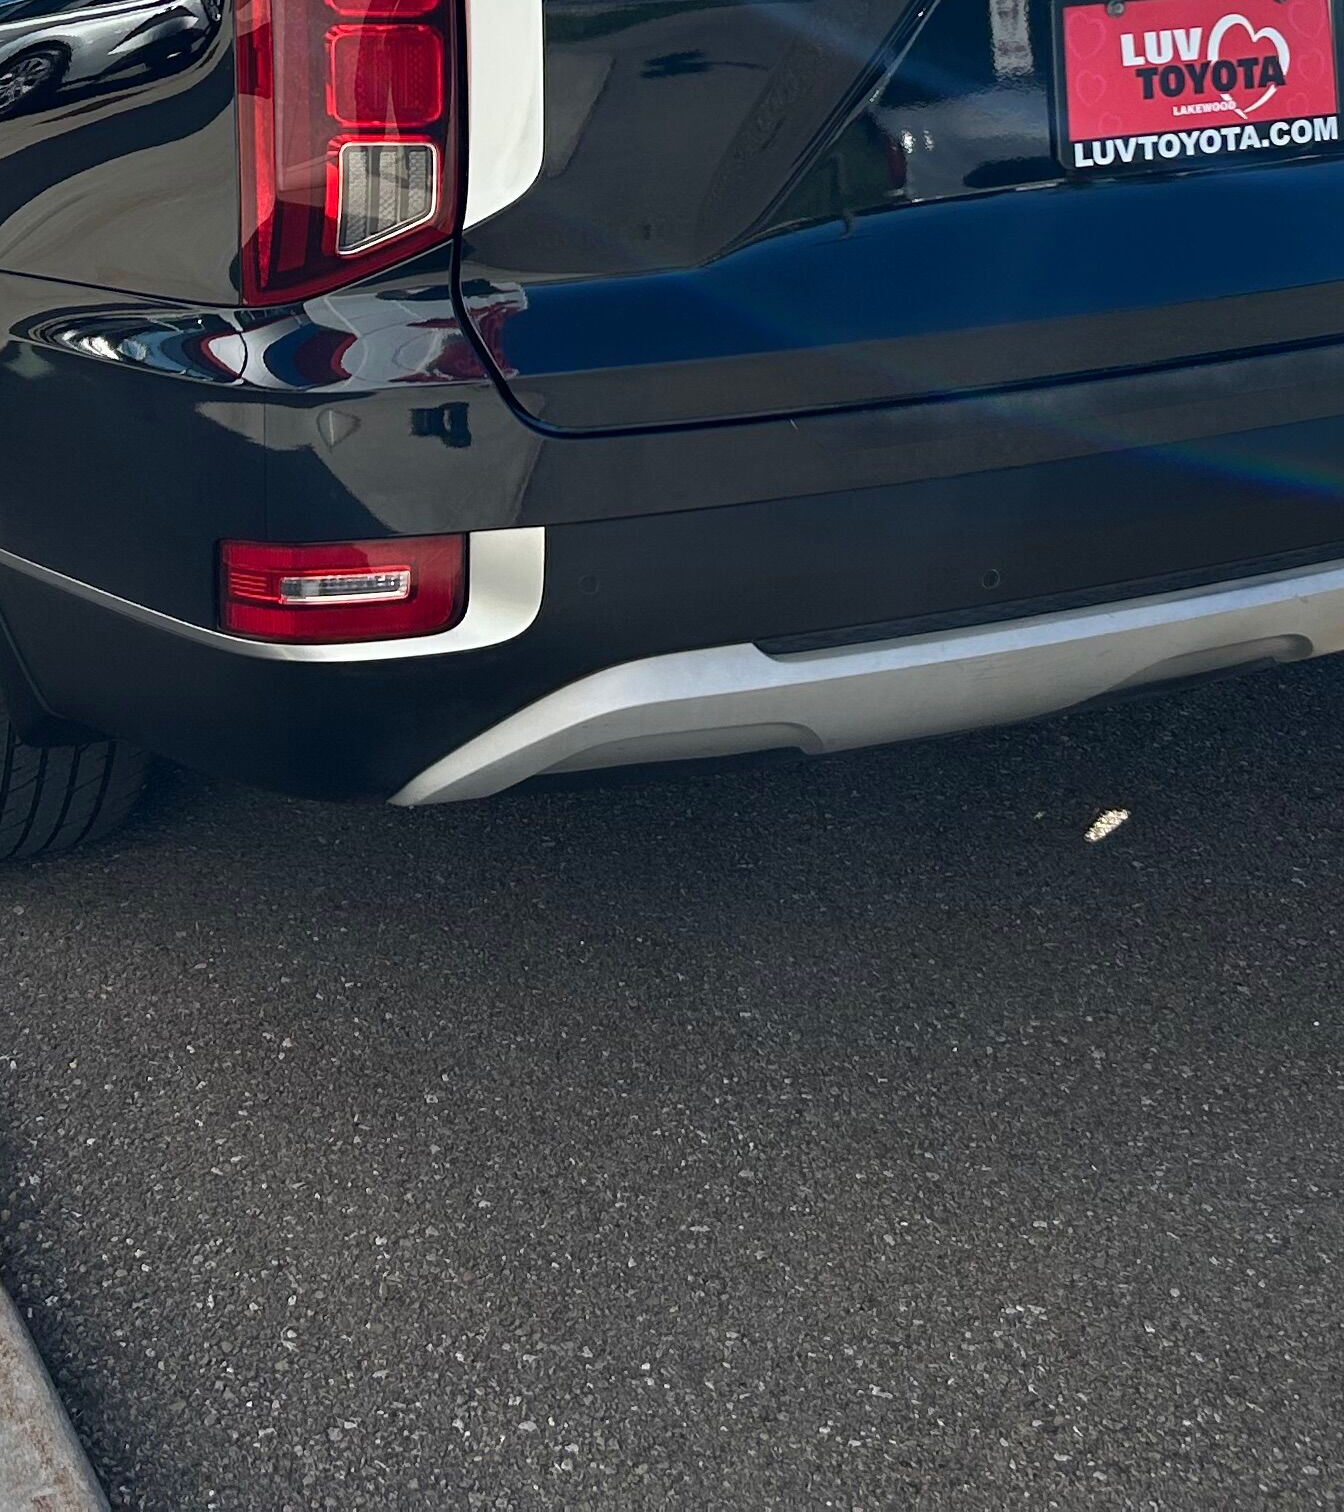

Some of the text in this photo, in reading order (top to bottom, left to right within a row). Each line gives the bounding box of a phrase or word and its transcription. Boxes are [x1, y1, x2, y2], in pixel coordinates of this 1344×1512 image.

[1120, 27, 1203, 66] LUV
[1136, 55, 1286, 100] TOYOTA
[1173, 100, 1237, 116] LAKEWOOD
[1074, 116, 1339, 168] LUVTOYOTA.COM
